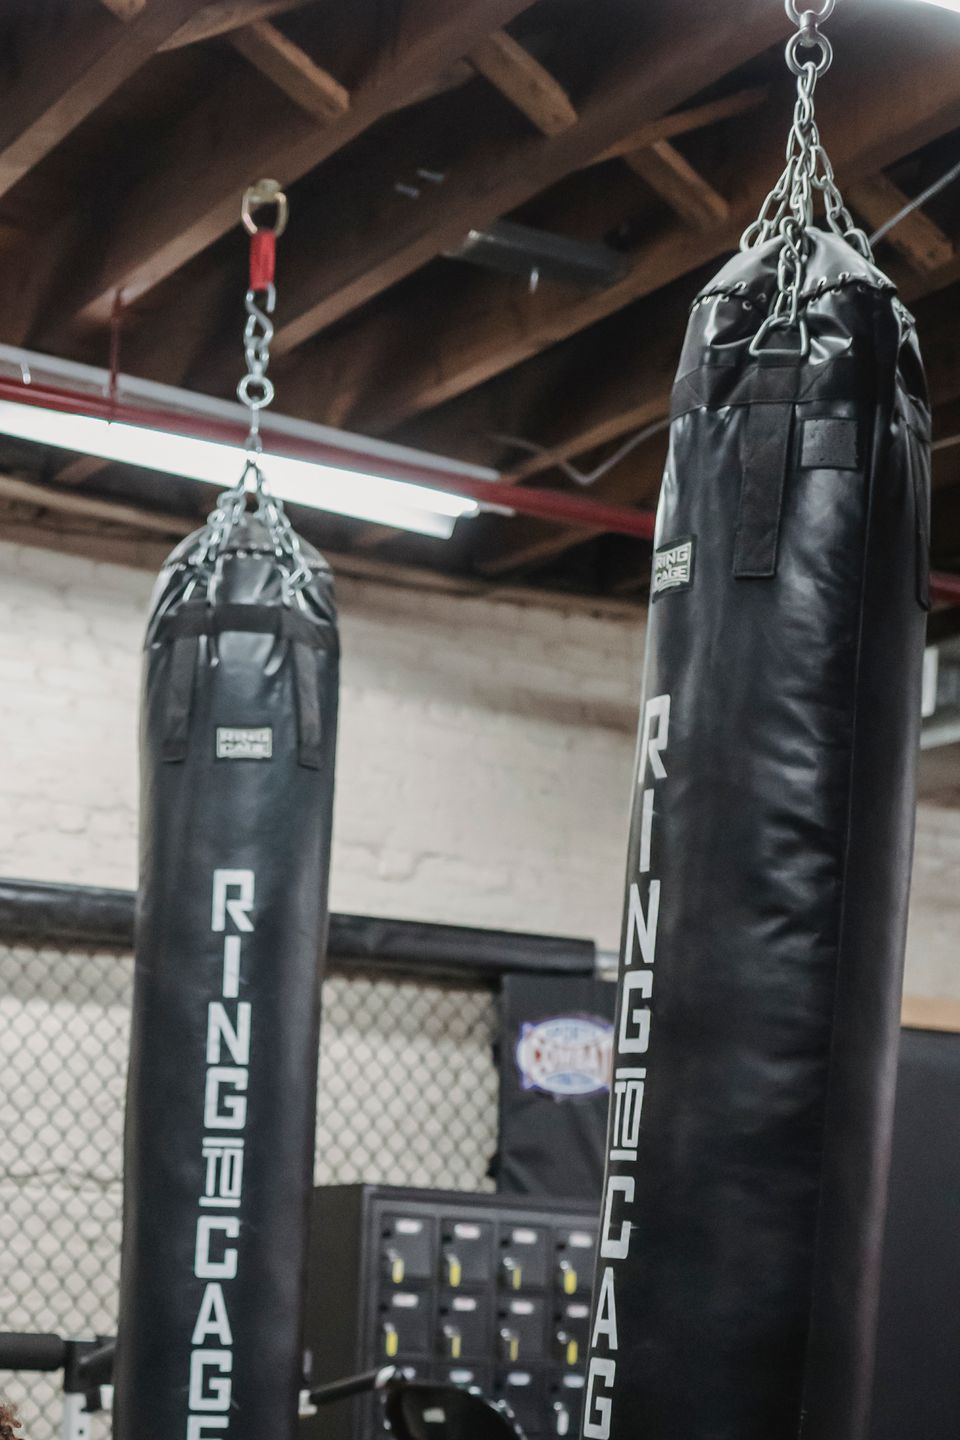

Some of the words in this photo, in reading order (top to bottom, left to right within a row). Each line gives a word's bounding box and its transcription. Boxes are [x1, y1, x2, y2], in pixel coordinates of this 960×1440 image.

[655, 565, 688, 584] CAGE
[656, 547, 688, 570] RING
[617, 694, 671, 1054] RING
[203, 867, 255, 1130] RING
[613, 1080, 645, 1149] TO
[201, 1147, 244, 1198] TO
